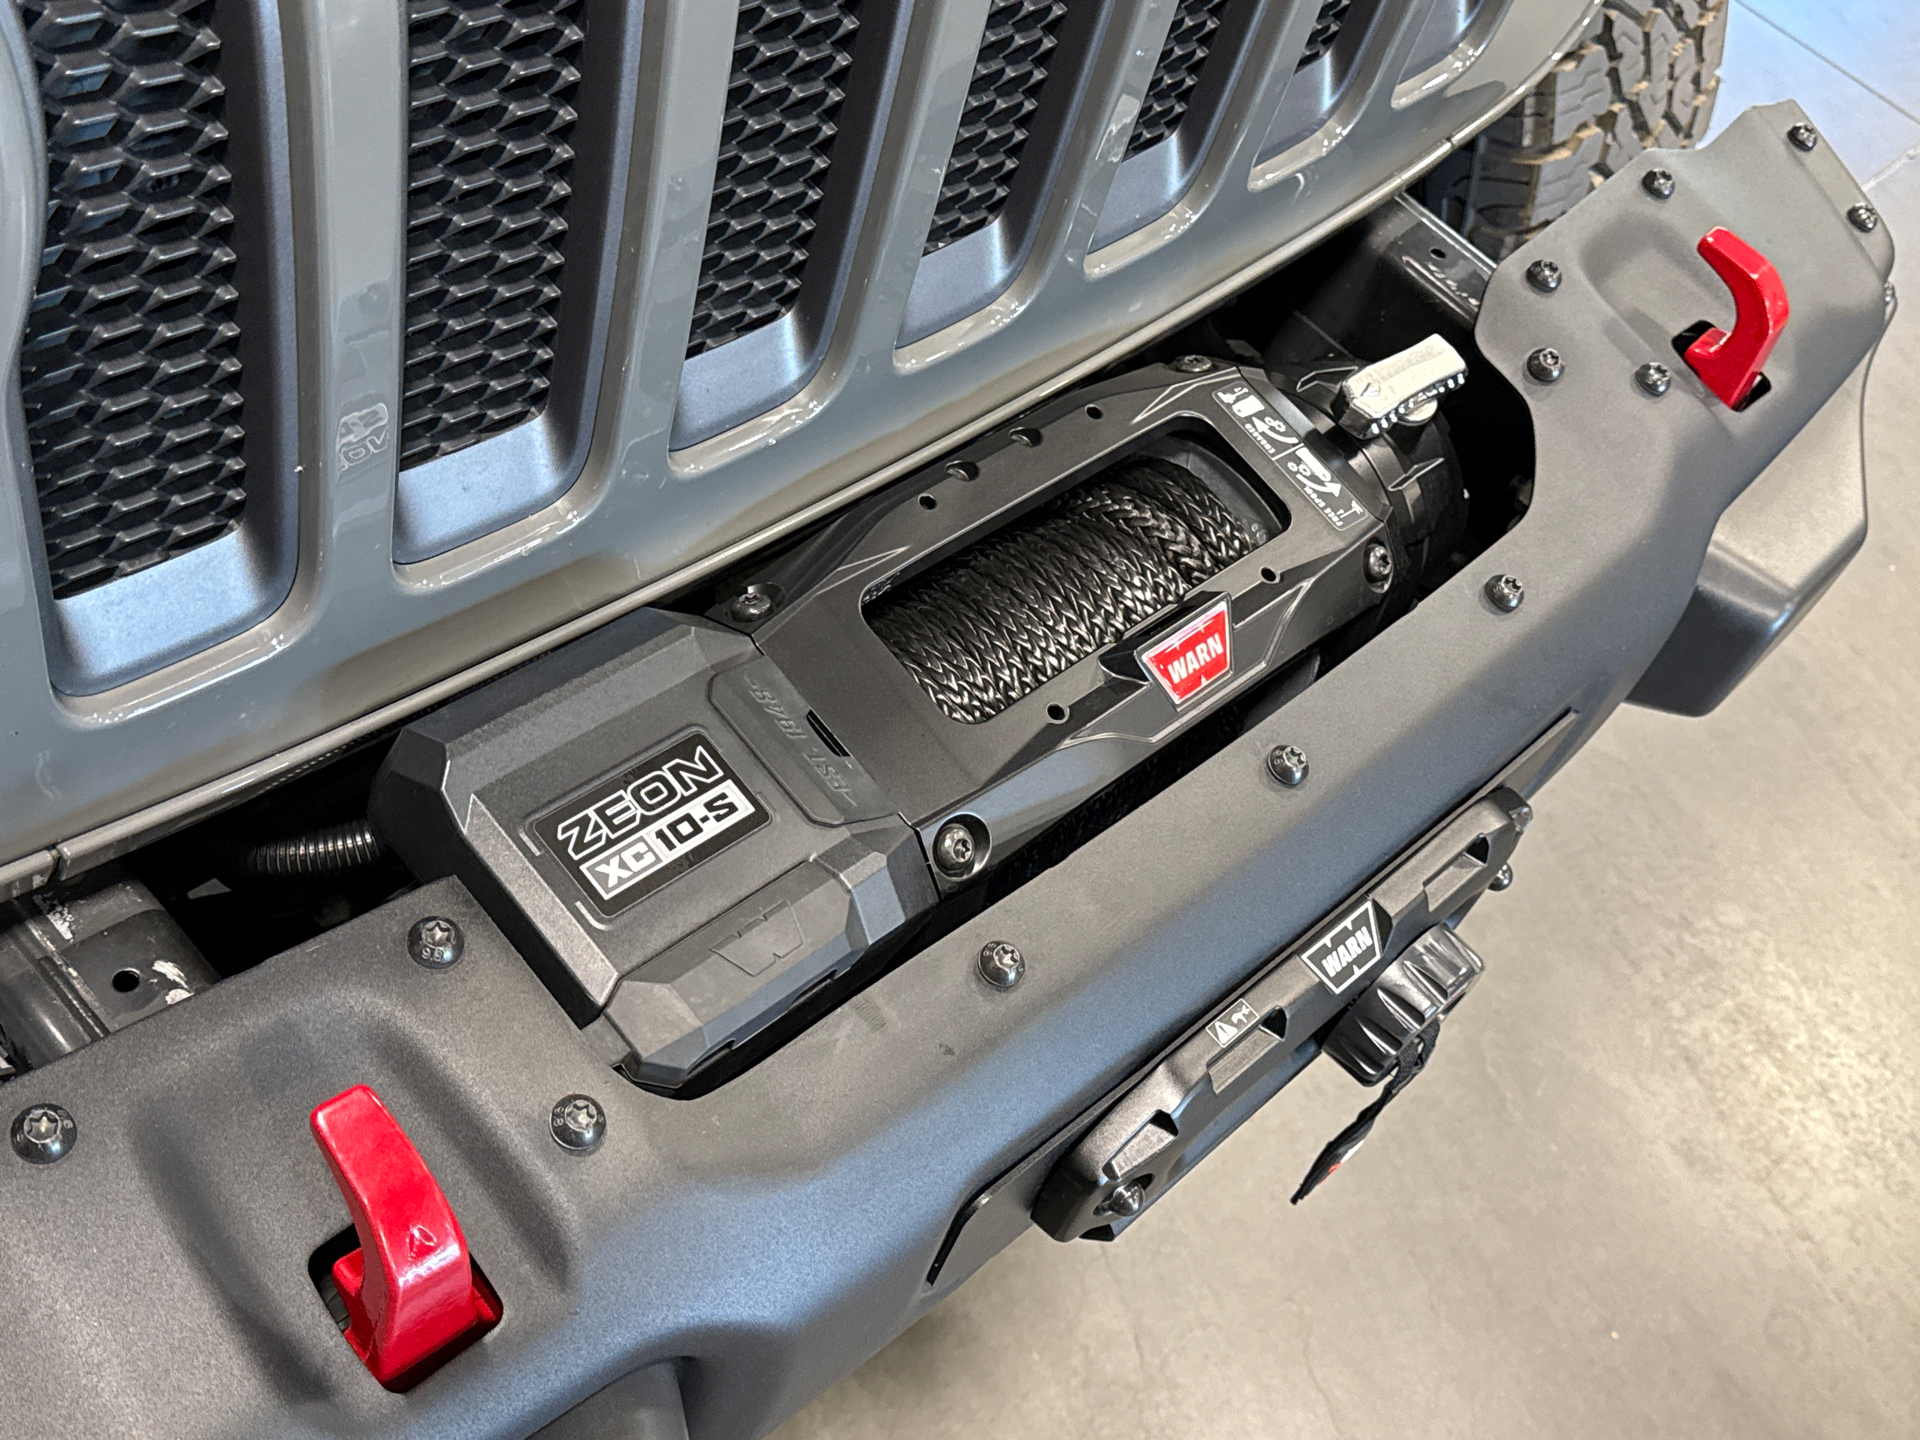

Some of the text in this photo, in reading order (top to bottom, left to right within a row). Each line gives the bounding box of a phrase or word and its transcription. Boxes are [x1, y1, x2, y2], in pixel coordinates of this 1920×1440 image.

[1245, 423, 1276, 454] ENGAGED
[1303, 486, 1344, 526] FREE SPOOL
[1166, 632, 1224, 684] WARN
[748, 688, 807, 737] 1948
[557, 745, 724, 860] ZEON
[594, 842, 656, 888] XC
[1321, 925, 1373, 978] WARN
